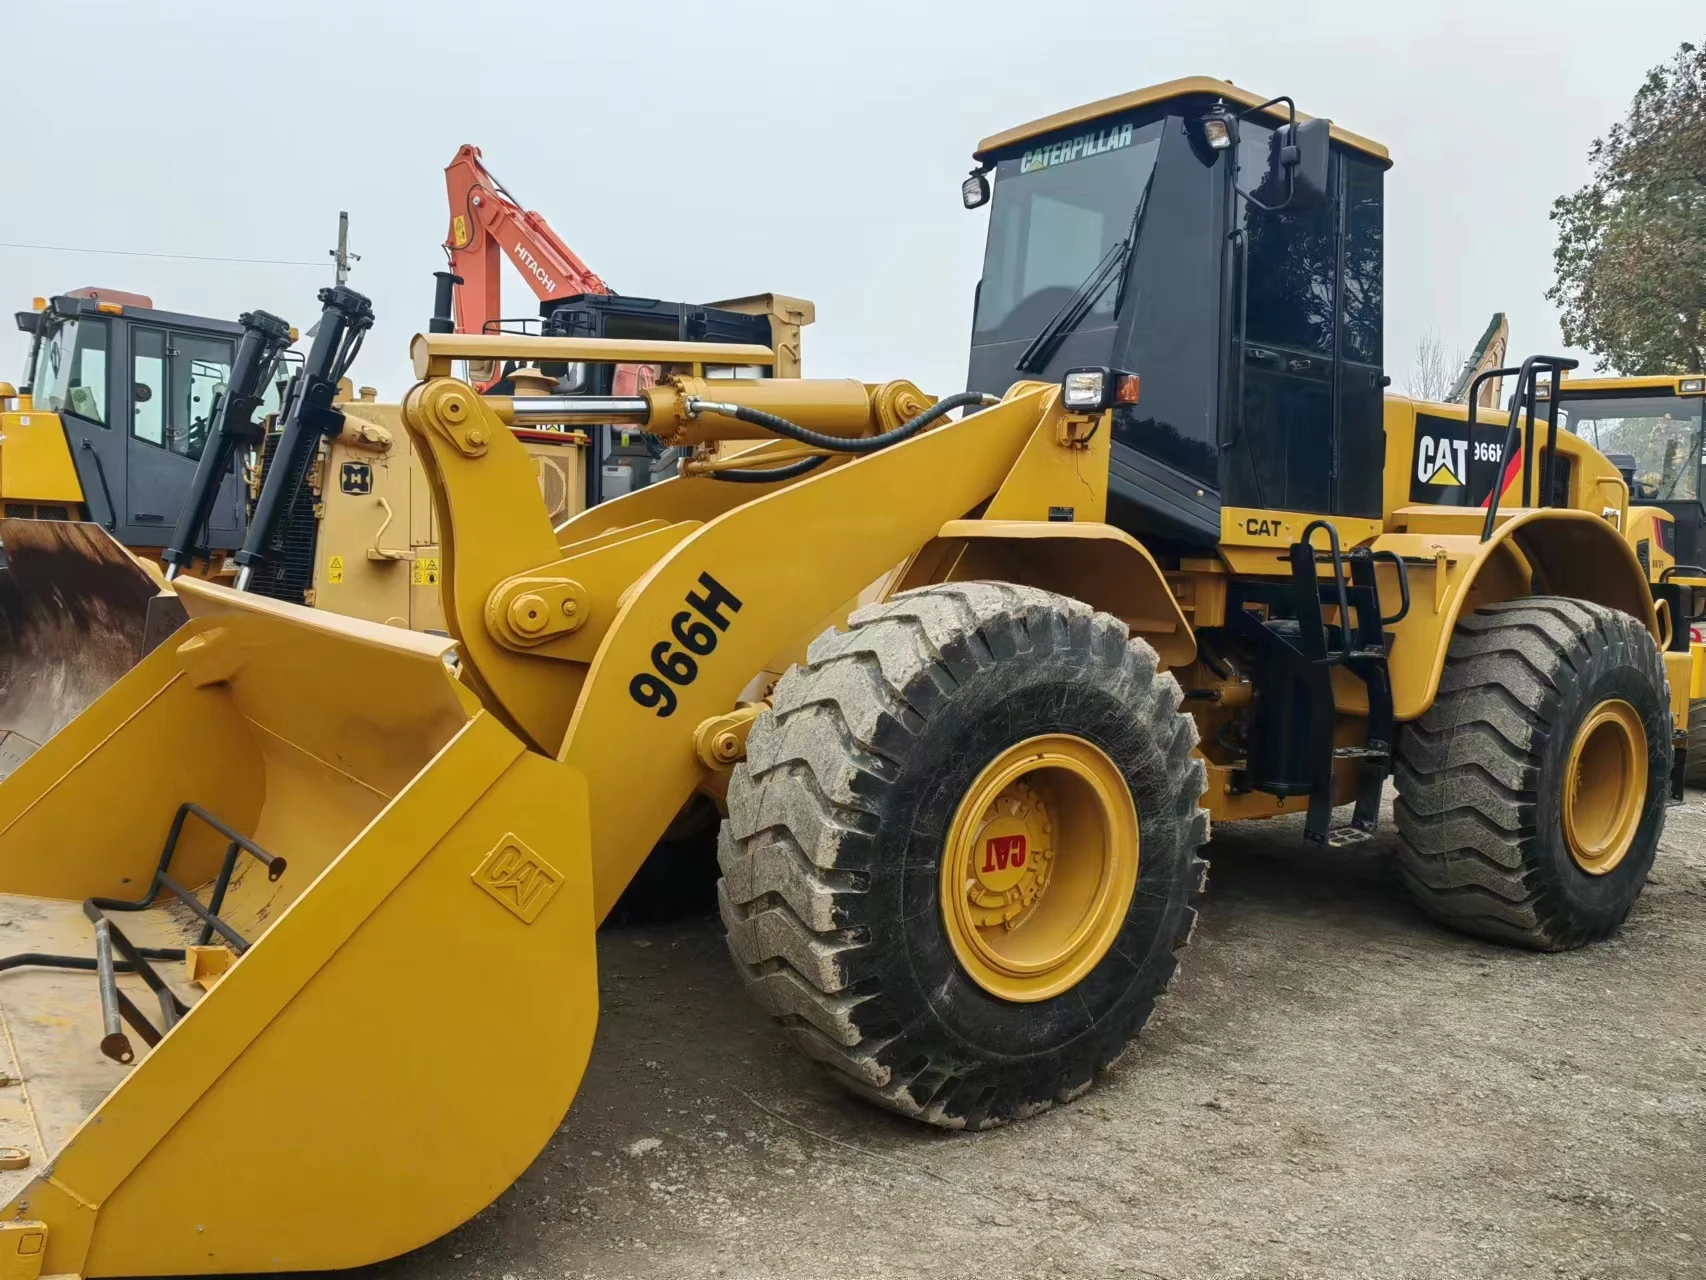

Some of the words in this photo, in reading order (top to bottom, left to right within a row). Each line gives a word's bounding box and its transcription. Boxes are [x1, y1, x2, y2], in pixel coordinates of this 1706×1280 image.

[1020, 123, 1133, 174] CATERPILLAR
[513, 241, 556, 293] HITACHI
[1417, 435, 1468, 486] CAT
[1246, 518, 1282, 537] CAT
[629, 571, 743, 718] 966H
[484, 845, 556, 912] CAT
[982, 834, 1026, 873] CAT
